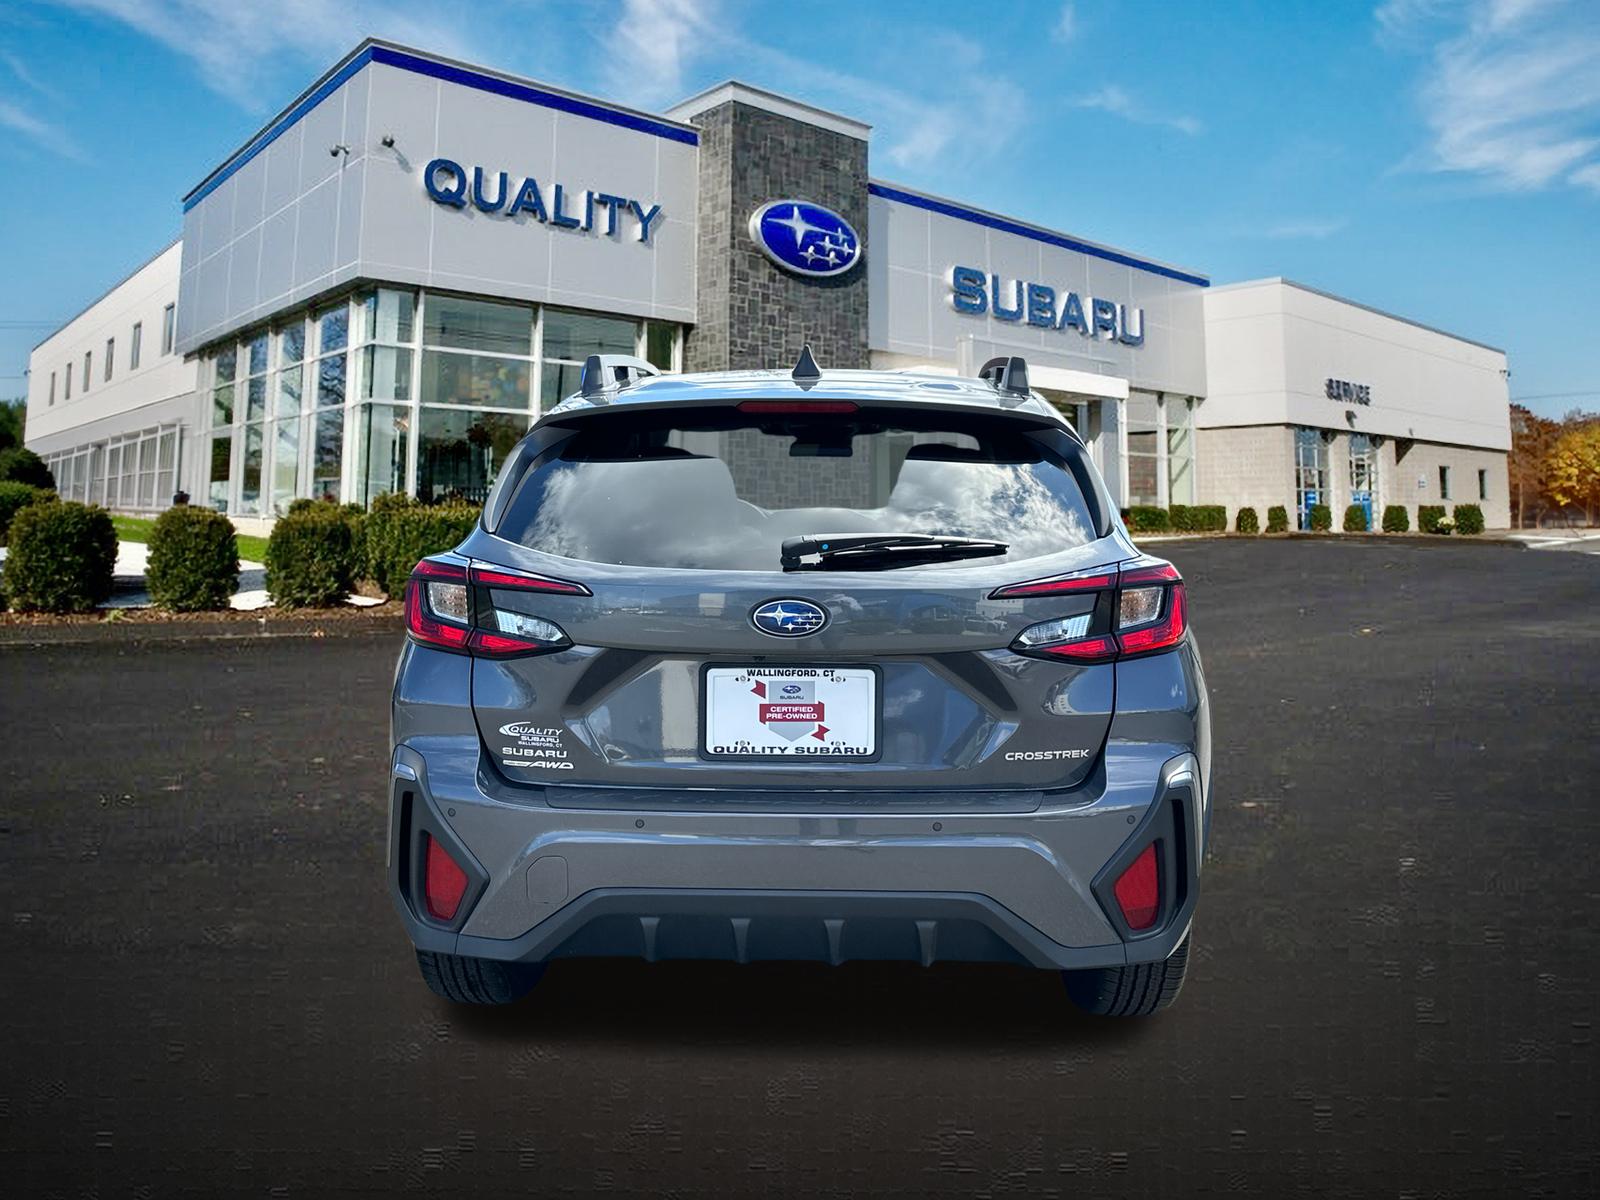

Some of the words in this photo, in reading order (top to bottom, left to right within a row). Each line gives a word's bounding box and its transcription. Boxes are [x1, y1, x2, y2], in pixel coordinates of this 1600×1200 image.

[424, 158, 662, 242] QUALITY
[950, 265, 1145, 347] SUBARU
[507, 725, 563, 736] QUALITY
[502, 747, 567, 758] SUBARU
[713, 746, 788, 754] QUALITY
[795, 747, 867, 755] SUBARU
[1005, 749, 1090, 761] CROSSTREK
[529, 761, 574, 769] AWD
